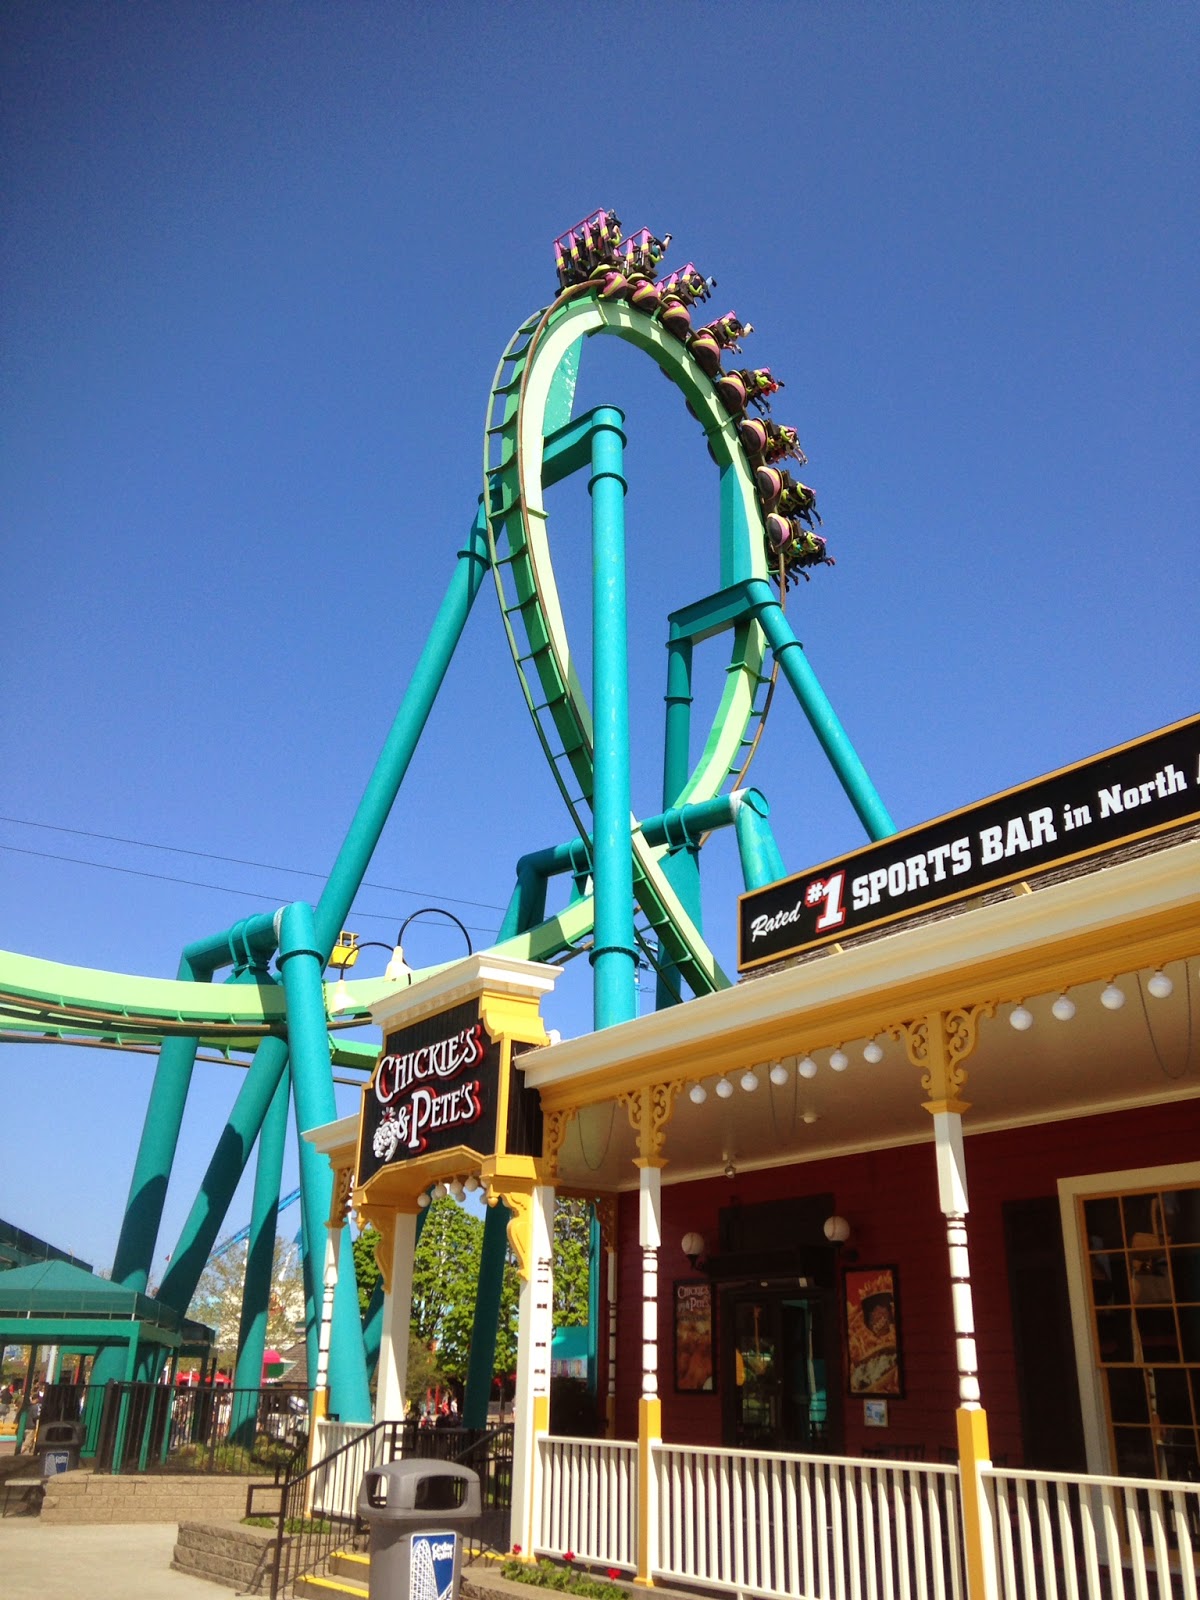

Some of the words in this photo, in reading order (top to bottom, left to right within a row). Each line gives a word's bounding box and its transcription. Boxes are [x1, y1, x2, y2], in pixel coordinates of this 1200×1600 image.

[750, 900, 802, 943] Rated
[806, 873, 844, 930] #1
[851, 836, 972, 911] SPORTS
[979, 806, 1058, 866] BAR
[1063, 803, 1093, 832] in
[1097, 763, 1188, 819] North
[375, 1026, 478, 1104] CHICKIE'S
[396, 1106, 410, 1141] &
[408, 1082, 476, 1149] PETE'S
